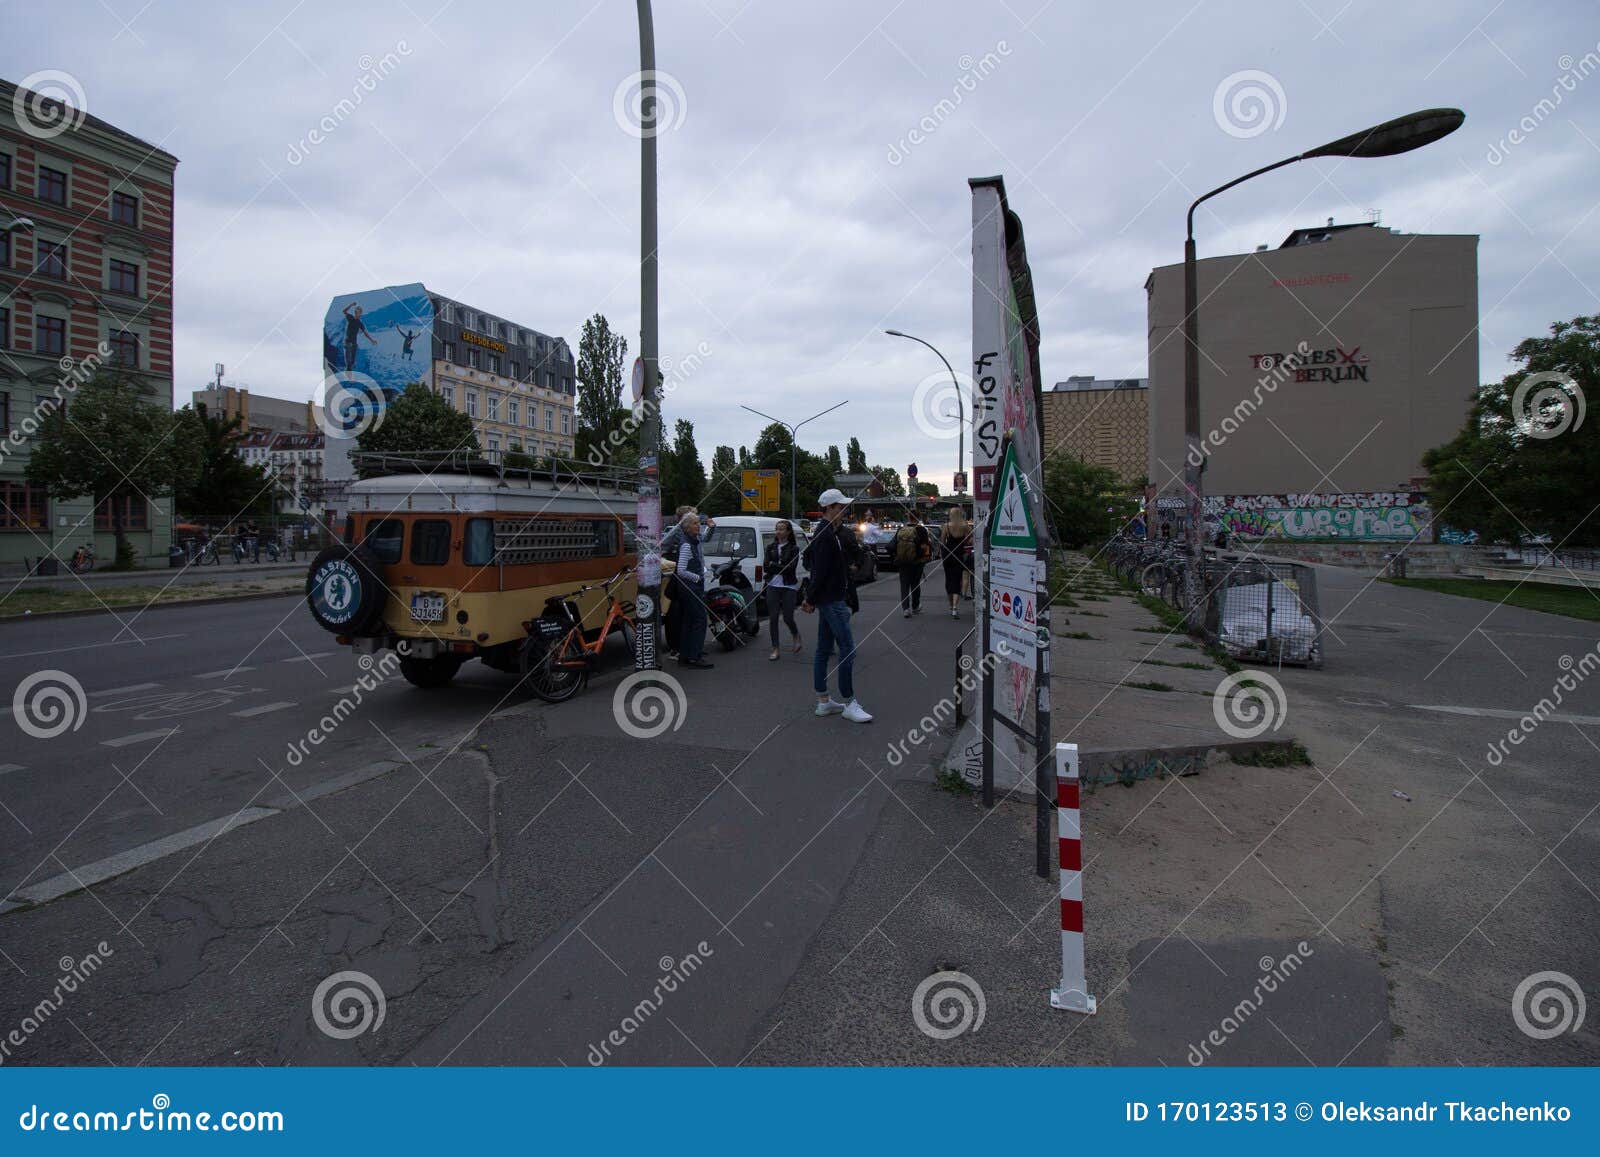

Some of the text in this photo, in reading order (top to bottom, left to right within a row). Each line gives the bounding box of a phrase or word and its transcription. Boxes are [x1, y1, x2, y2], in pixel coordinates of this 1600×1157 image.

[1293, 365, 1368, 384] BERLIN
[314, 561, 358, 585] EASTERN
[643, 622, 655, 669] MUSEUM
